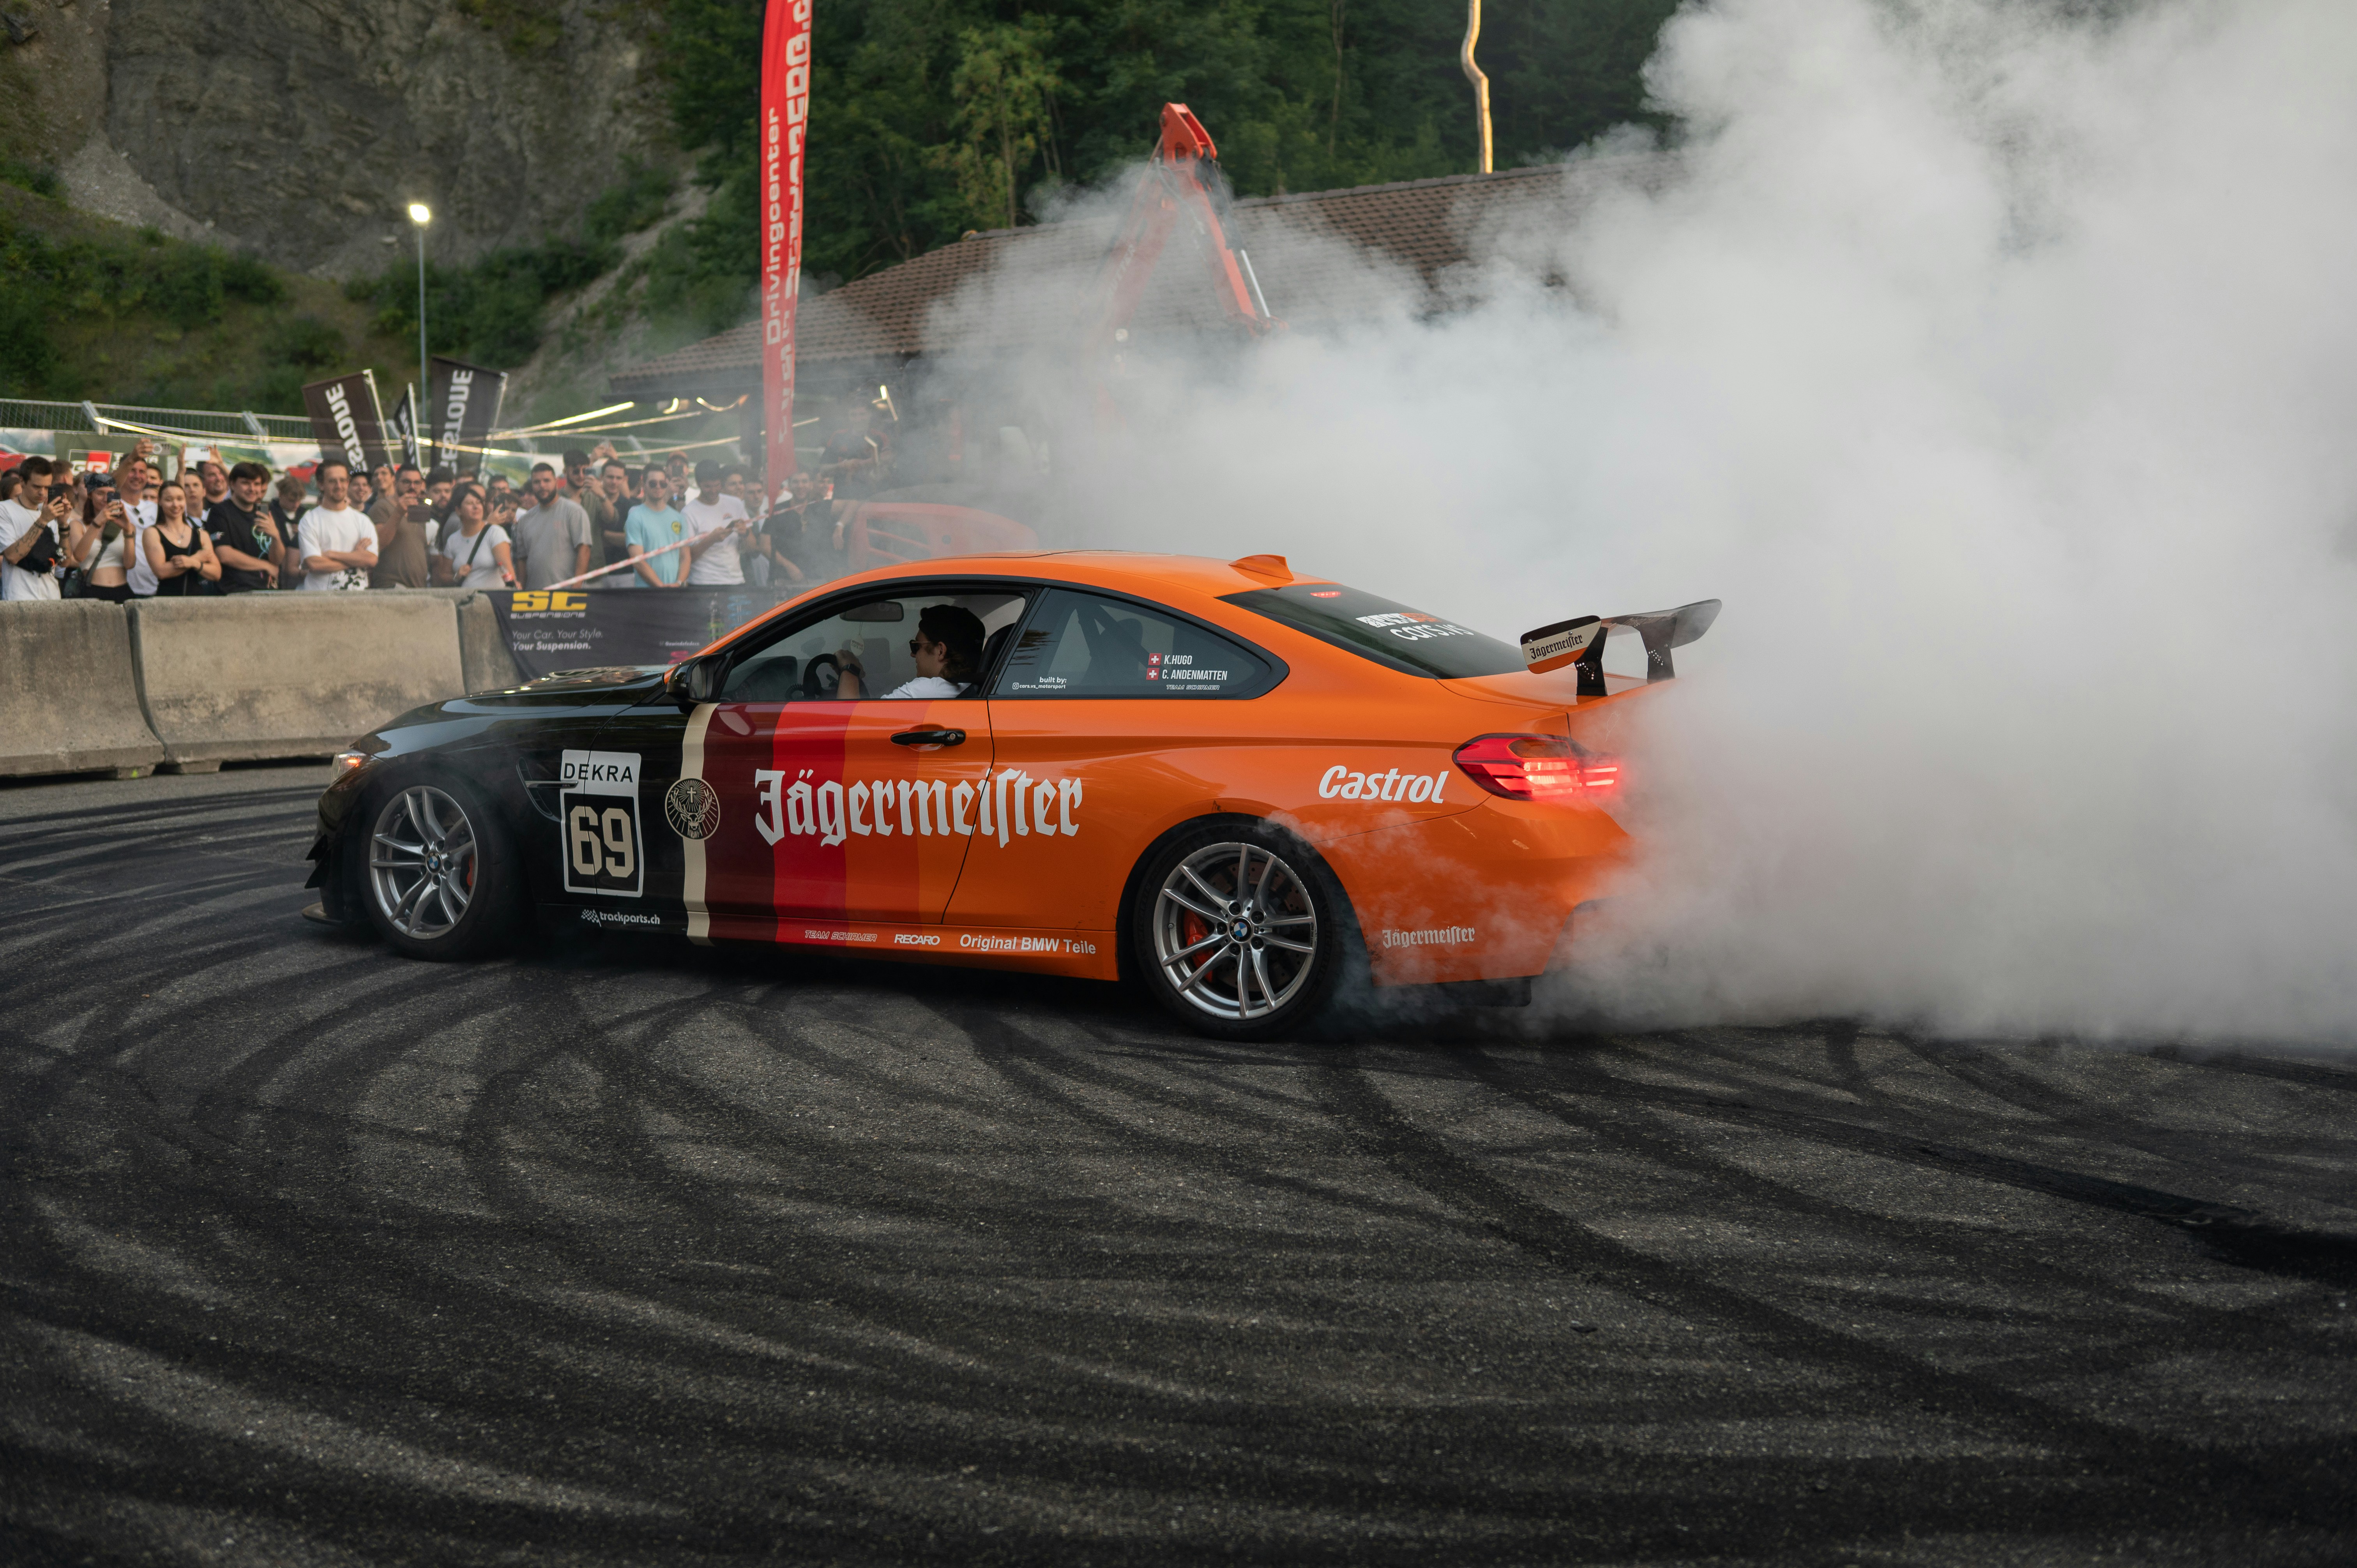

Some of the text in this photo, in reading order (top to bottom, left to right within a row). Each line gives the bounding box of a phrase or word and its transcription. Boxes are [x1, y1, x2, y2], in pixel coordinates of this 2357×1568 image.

[766, 107, 784, 345] Drivingcenter
[512, 627, 603, 641] Your Car. Your Style.
[1390, 624, 1474, 641] cars.vs
[513, 641, 591, 653] Your Suspension.
[1164, 655, 1193, 665] K.HUGO
[1057, 676, 1067, 685] by:
[1162, 669, 1228, 681] C. ANDENMATTEN
[564, 763, 633, 783] DEKRA
[1318, 765, 1449, 804] Castrol
[570, 805, 634, 878] 69
[600, 911, 661, 925] trackparts.ch
[805, 930, 878, 942] TEAM SCHIRMER
[894, 934, 940, 946] RECARO
[960, 934, 1096, 954] Original BMW Teile
